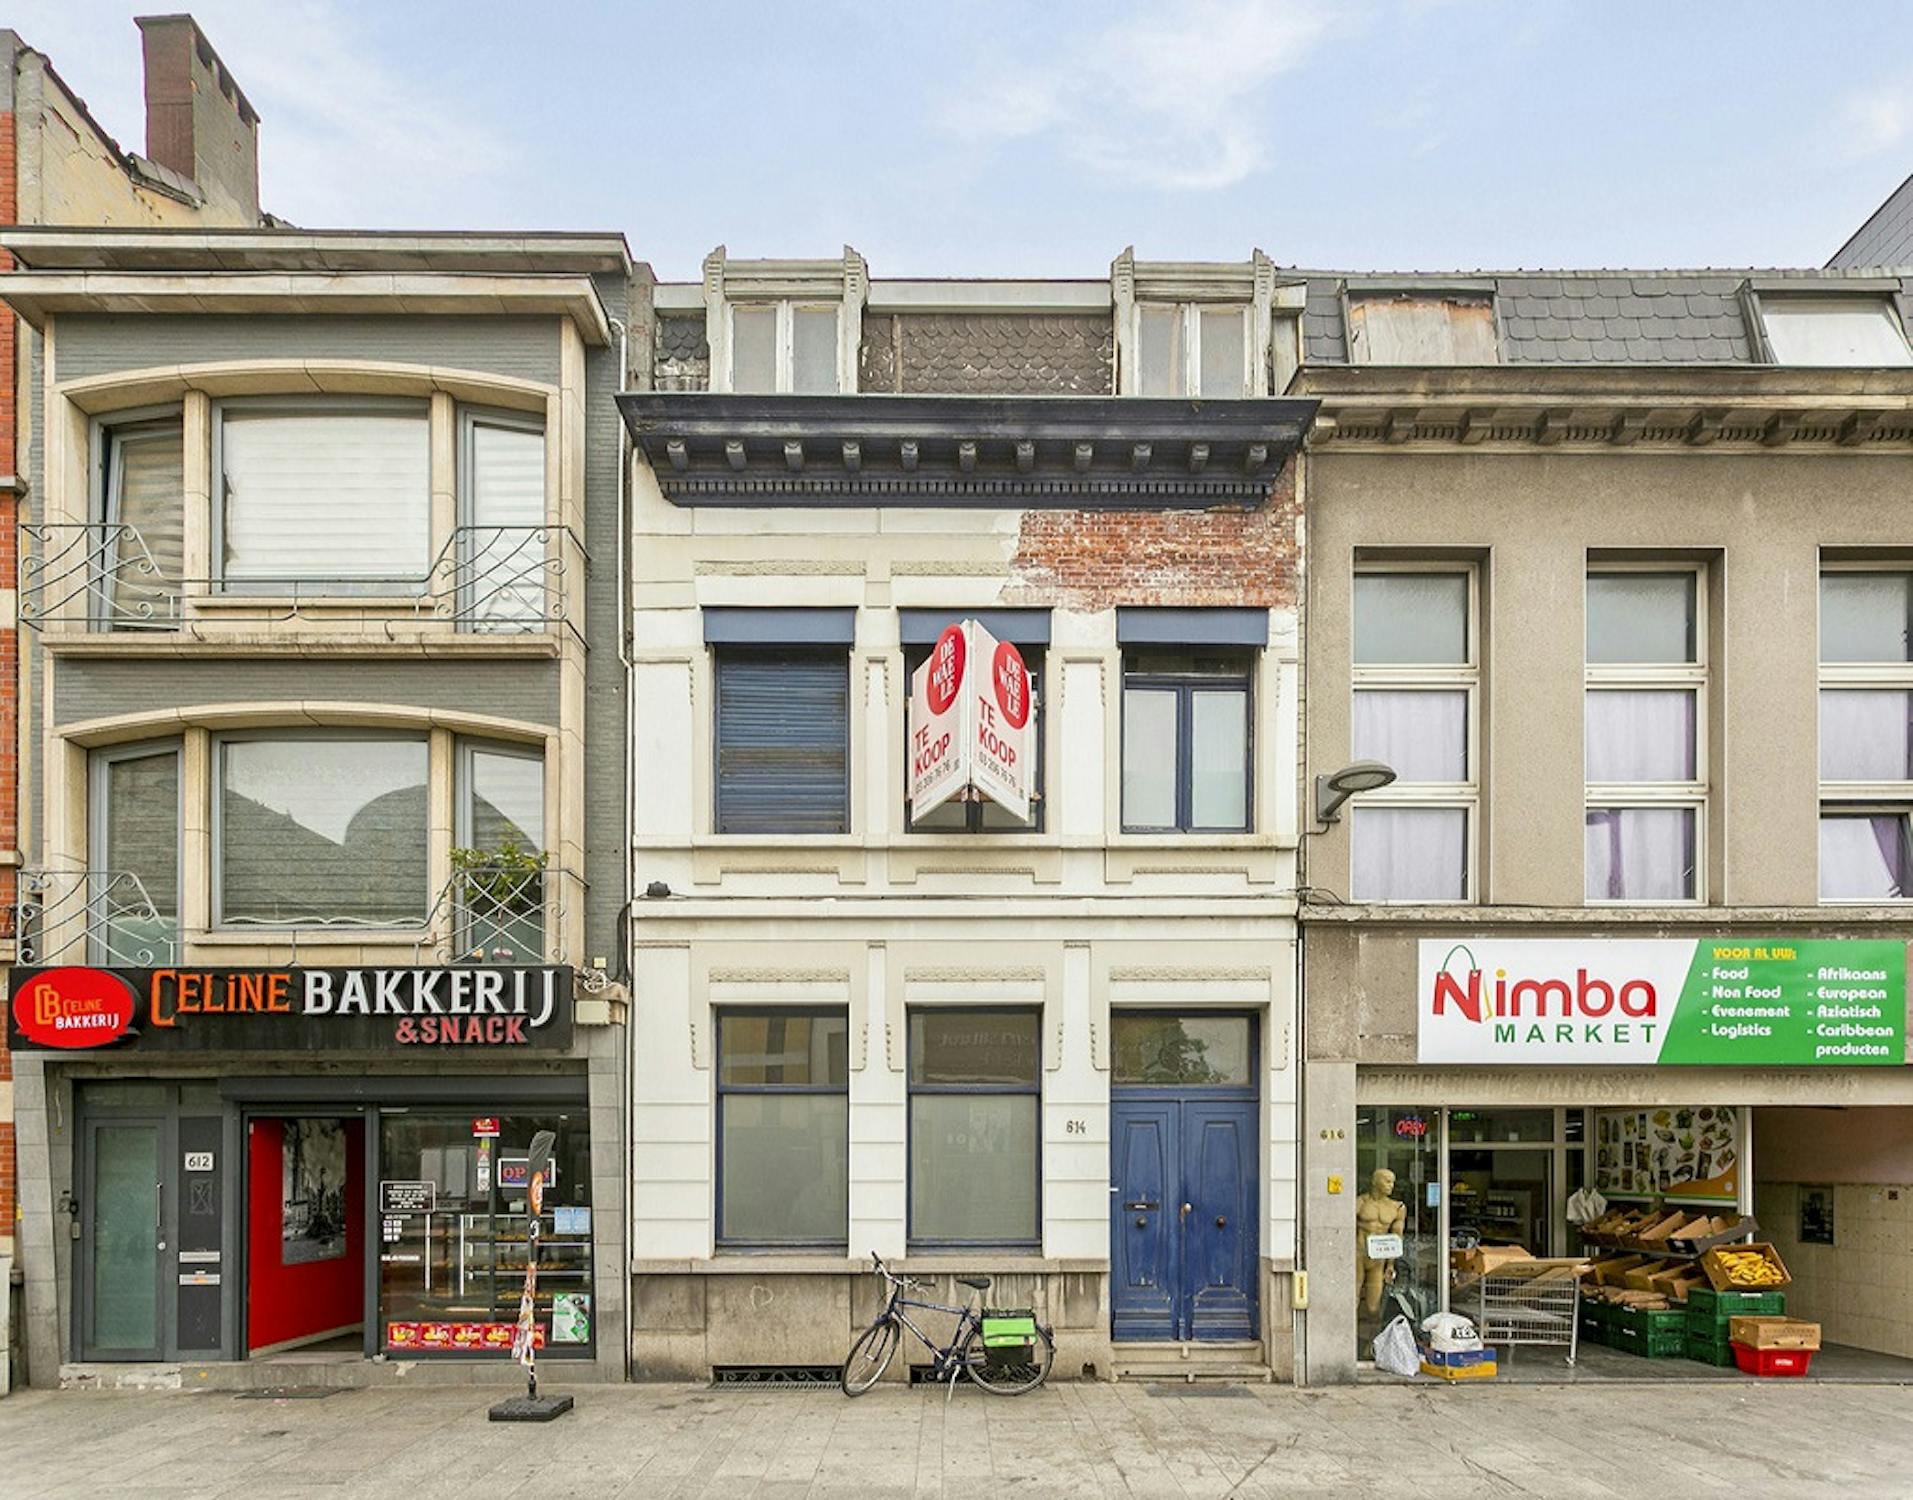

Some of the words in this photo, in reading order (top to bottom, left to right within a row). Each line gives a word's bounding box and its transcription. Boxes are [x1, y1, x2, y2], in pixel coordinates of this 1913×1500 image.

[979, 696, 995, 728] TE
[915, 724, 929, 752] TE
[978, 723, 1016, 767] KOOP
[915, 732, 950, 778] KOOP
[1712, 966, 1749, 980] Food
[1817, 966, 1888, 981] Afrikaans
[302, 970, 555, 1027] BAKKERIJ
[1432, 968, 1656, 1023] Nimba
[1712, 985, 1741, 999] Non
[1744, 985, 1782, 999] Food
[1817, 986, 1888, 1002] European
[1711, 1004, 1791, 1018] Evenement
[1817, 1004, 1882, 1018] Aziatisch
[55, 1012, 120, 1031] BAKKERIJ
[395, 1016, 528, 1044] &SNACK
[1816, 1023, 1895, 1037] Caribbean
[1494, 1023, 1657, 1043] MARKET
[1711, 1022, 1772, 1040] Logistics
[1815, 1042, 1889, 1059] producten
[1066, 1120, 1086, 1134] 614
[1320, 1129, 1345, 1140] 616
[1395, 1119, 1427, 1136] OPEN
[188, 1156, 211, 1169] 612
